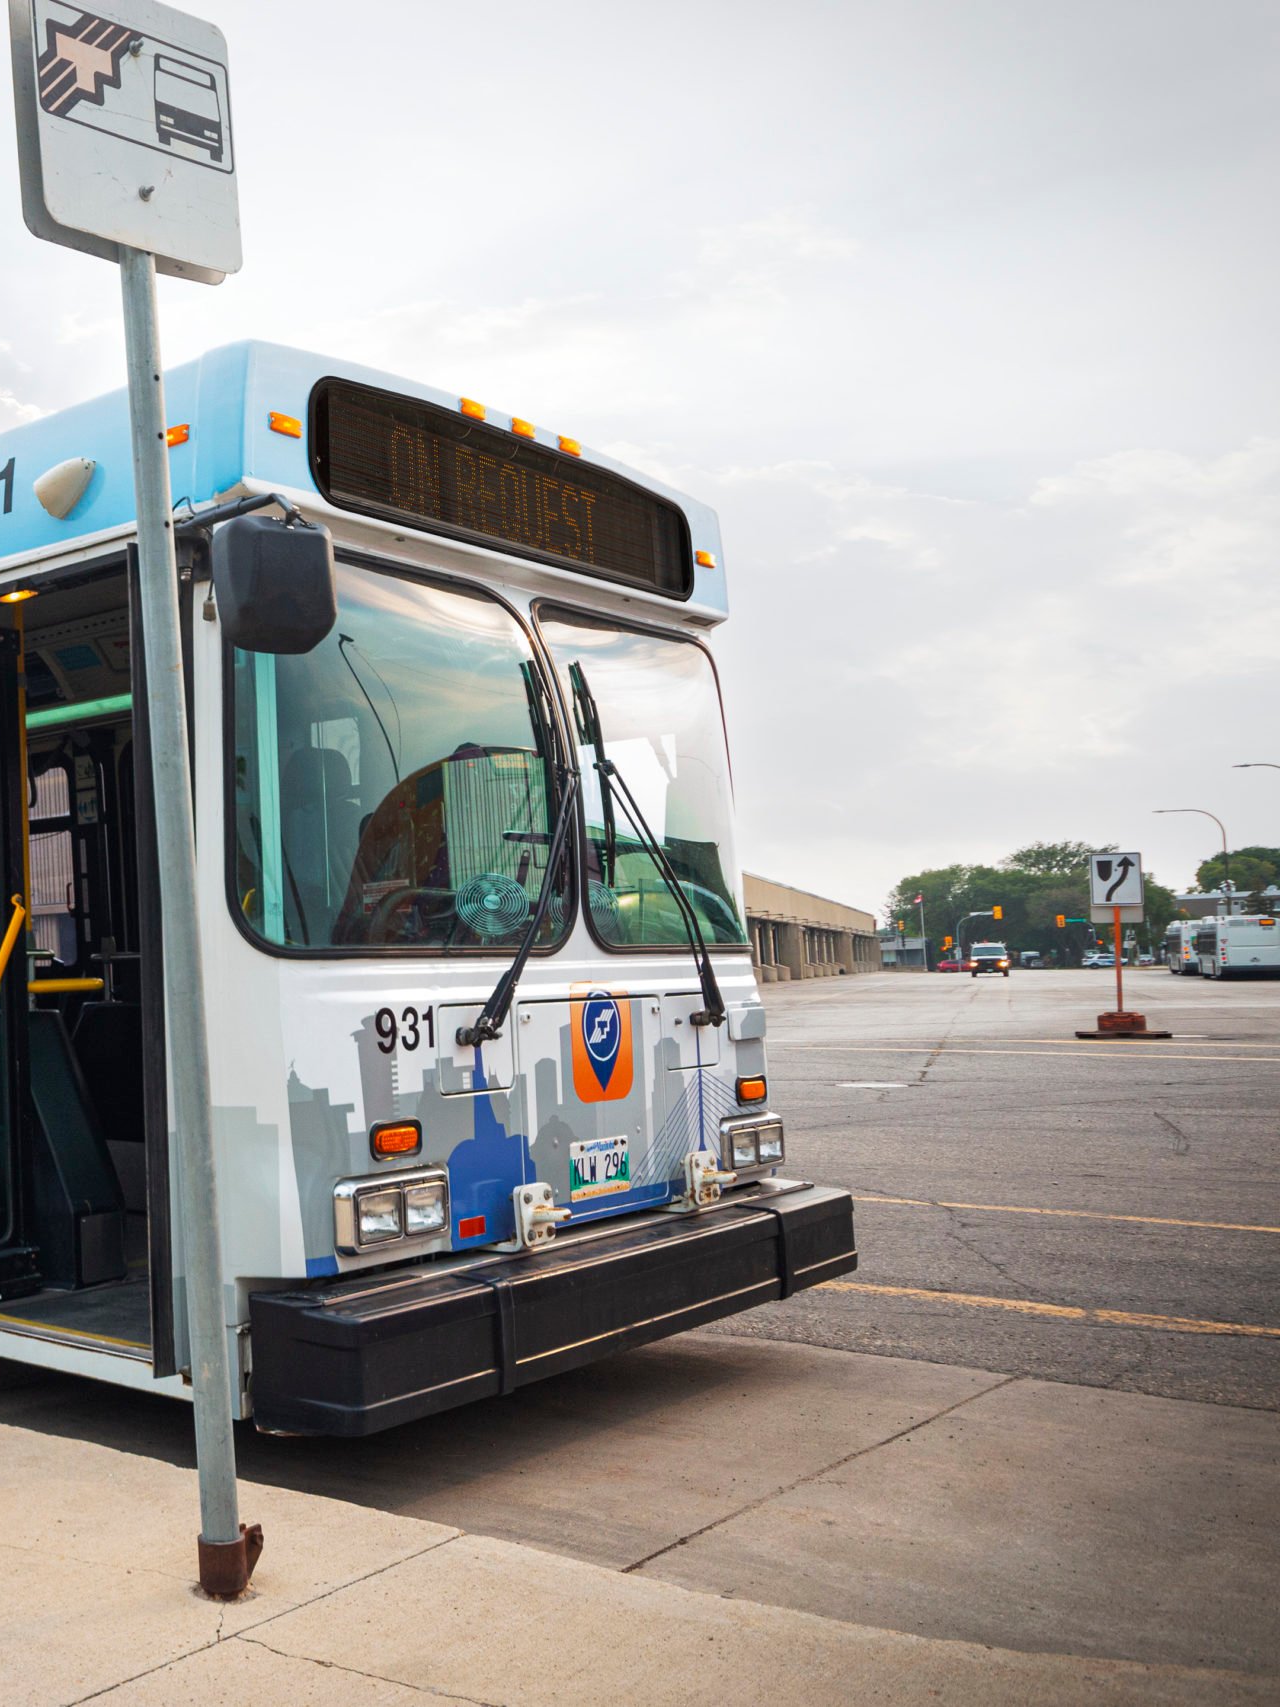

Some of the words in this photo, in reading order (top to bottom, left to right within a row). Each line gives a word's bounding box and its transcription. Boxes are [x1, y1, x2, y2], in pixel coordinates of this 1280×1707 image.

[390, 423, 441, 520] ON
[454, 445, 597, 565] REQUEST
[375, 1005, 436, 1054] 931
[574, 1155, 597, 1186] KLW
[604, 1151, 627, 1180] 296
